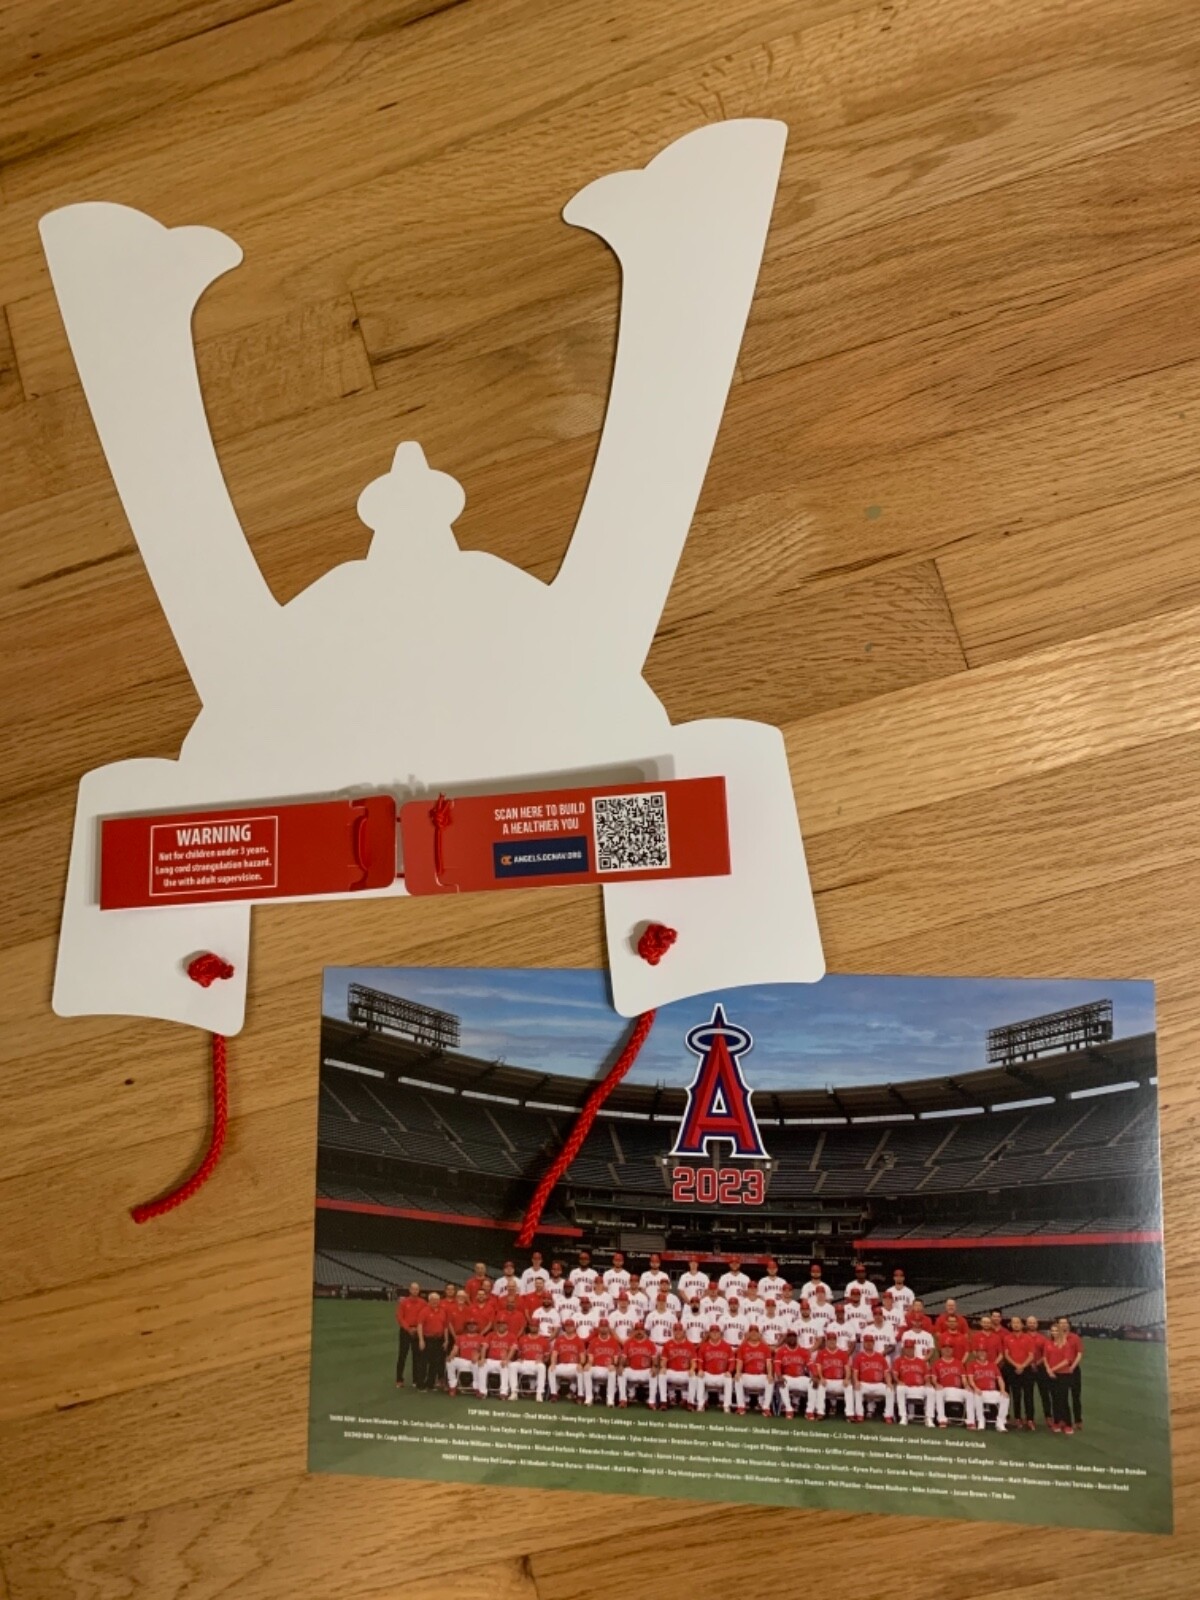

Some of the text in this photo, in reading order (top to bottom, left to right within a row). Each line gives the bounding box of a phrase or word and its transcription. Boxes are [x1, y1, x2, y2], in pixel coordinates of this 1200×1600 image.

[494, 802, 585, 821] SCAN HERE TO BUILD
[176, 824, 251, 846] WARNING
[503, 818, 579, 835] A HEALTHIER YOU
[158, 846, 268, 860] Not for children under 3 years.
[155, 857, 272, 875] Long cord strangulation hazard.
[163, 873, 262, 887] Use with adult supervision.
[673, 1167, 765, 1205] 2023
